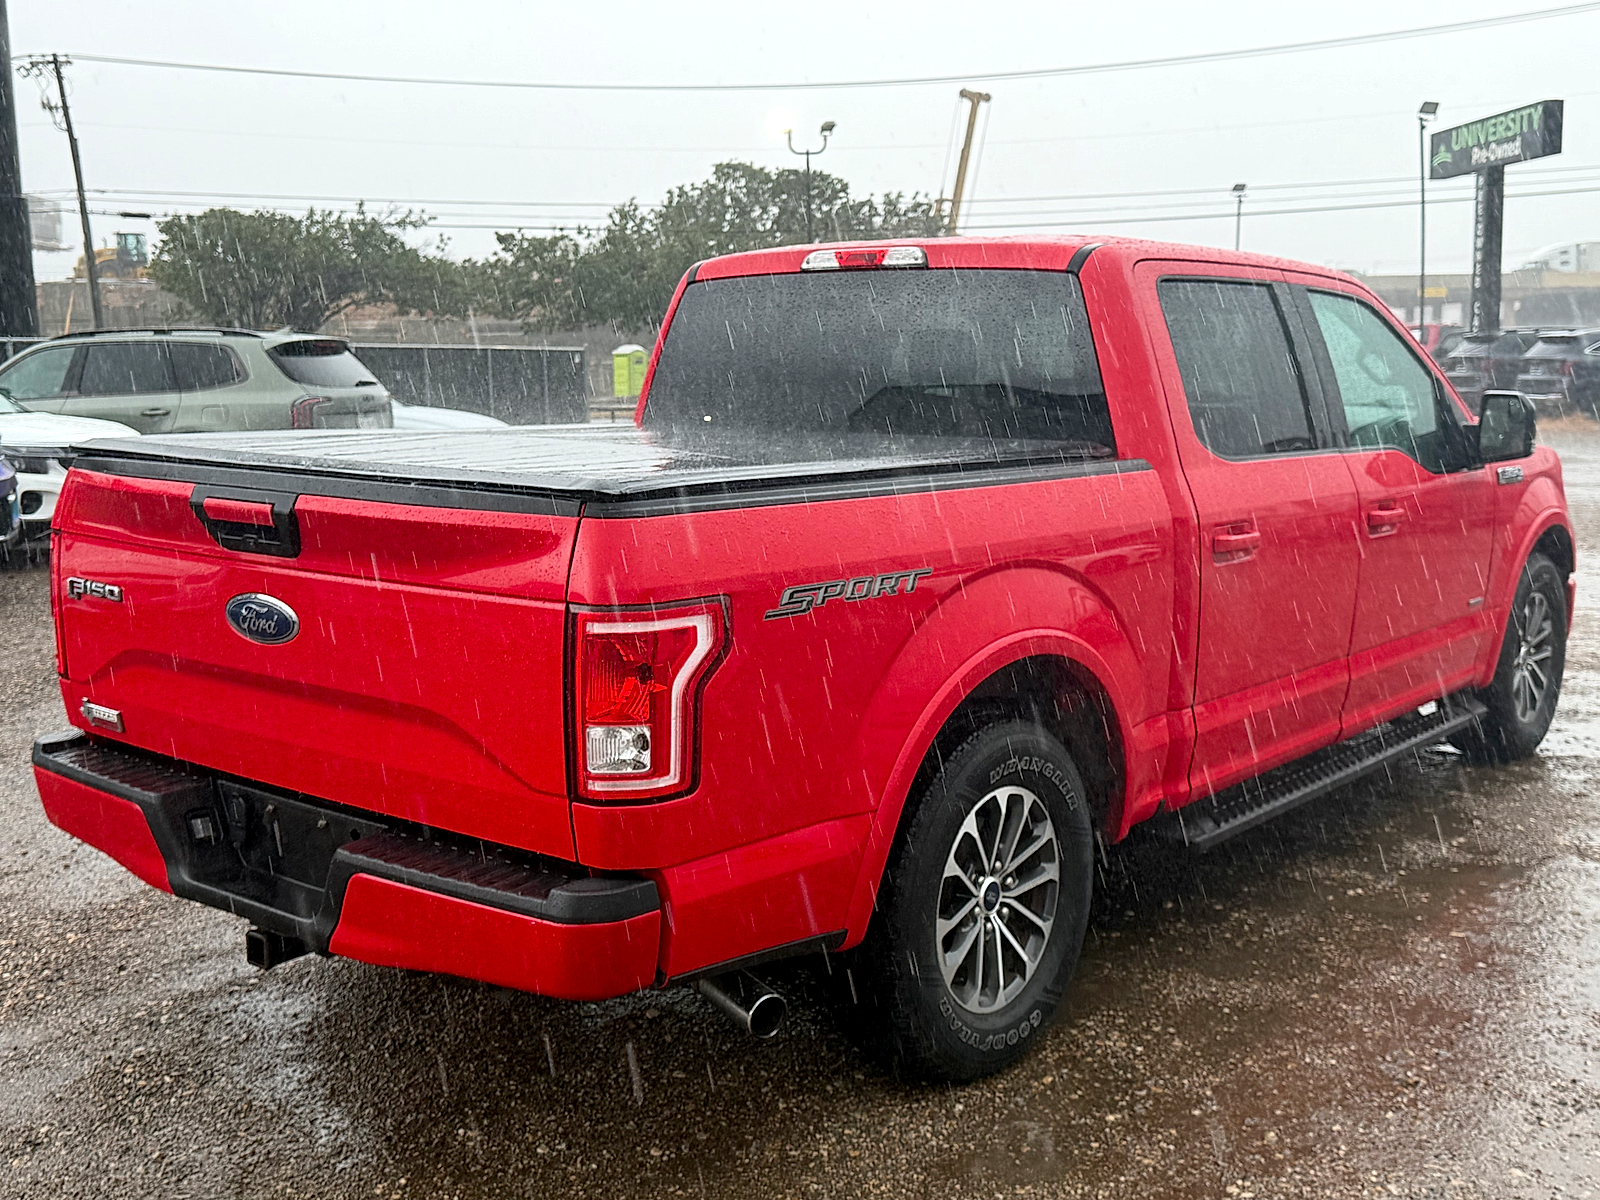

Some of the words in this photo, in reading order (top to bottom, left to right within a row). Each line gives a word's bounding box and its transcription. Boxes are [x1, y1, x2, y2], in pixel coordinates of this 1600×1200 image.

[1451, 105, 1543, 151] UNIVERSITY
[1471, 135, 1522, 165] Pre-Owned
[239, 603, 278, 635] Ford
[763, 567, 933, 621] SPORT
[989, 755, 1079, 811] WRANGLER
[938, 996, 1042, 1052] GOODYEAR
